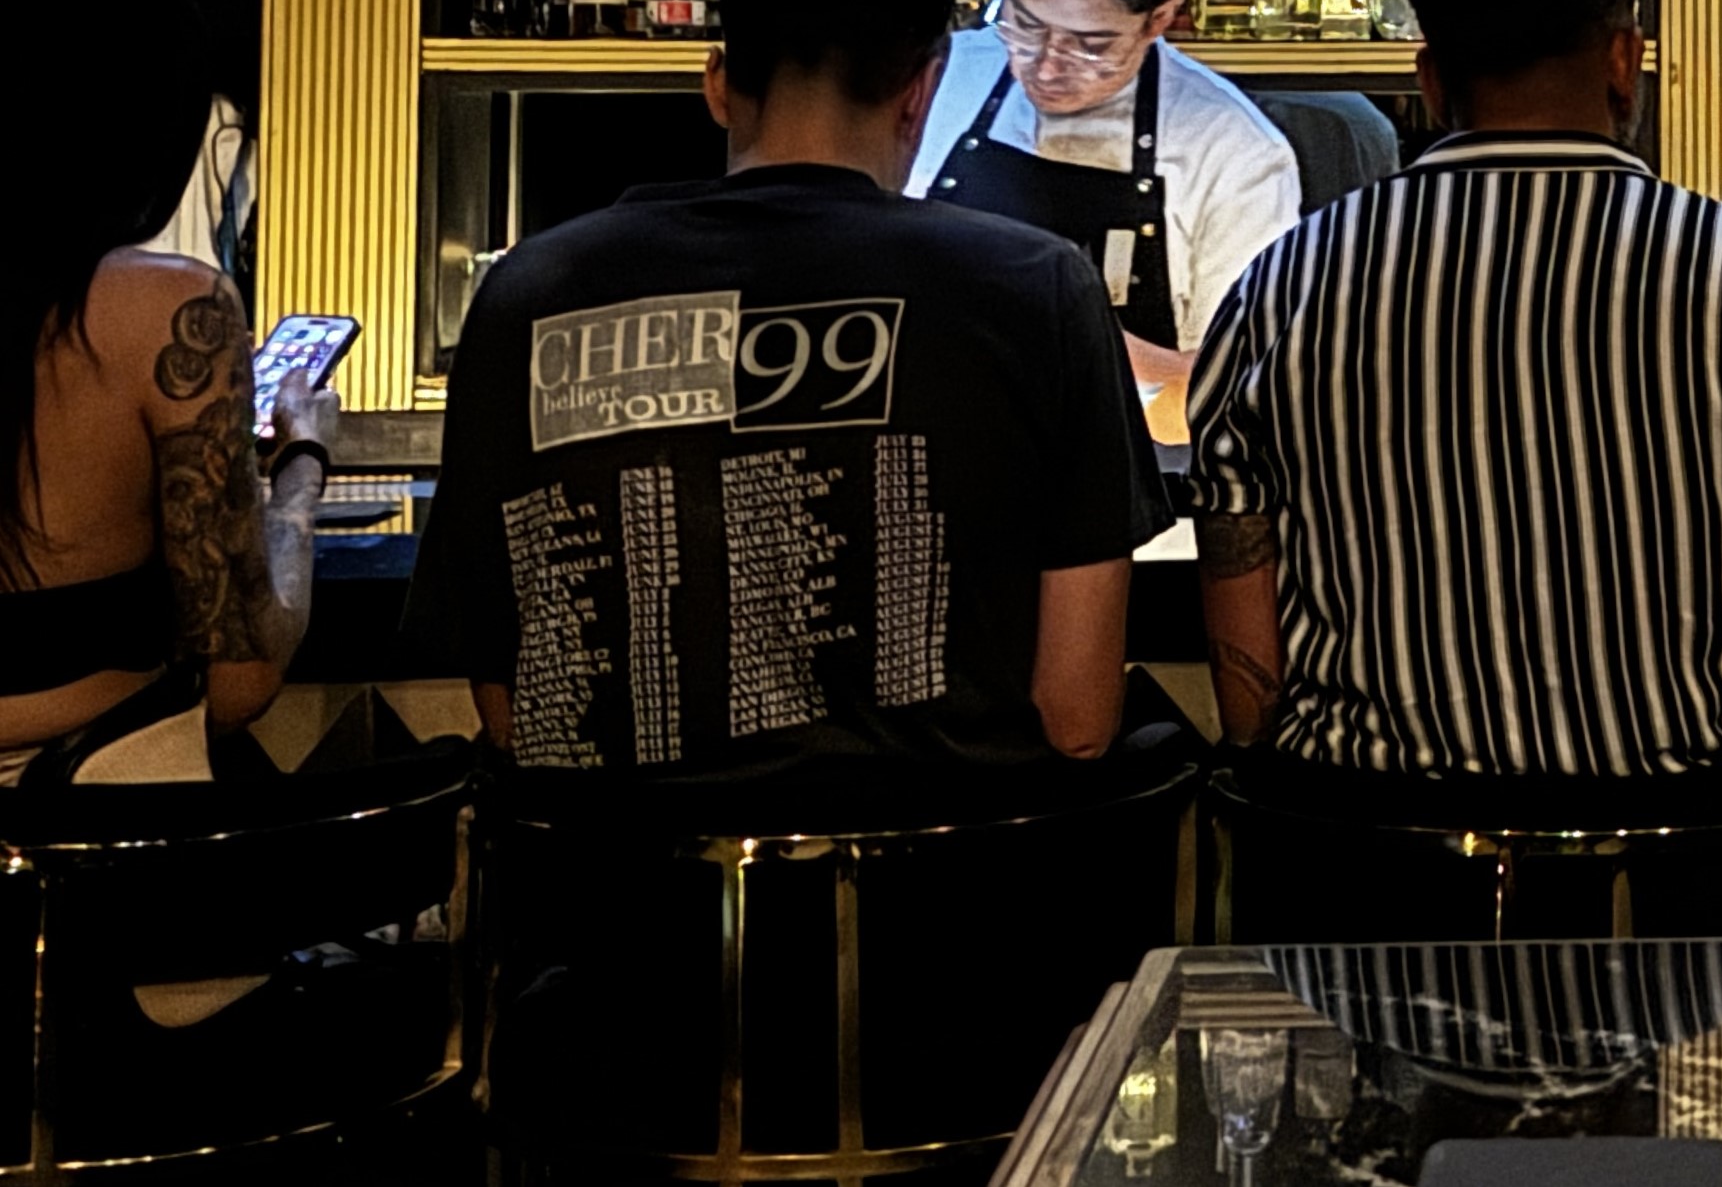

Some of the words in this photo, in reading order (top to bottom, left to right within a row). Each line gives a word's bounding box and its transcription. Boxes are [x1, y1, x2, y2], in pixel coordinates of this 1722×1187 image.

[533, 308, 733, 391] CHER
[737, 310, 889, 415] 99
[542, 384, 622, 415] believe
[598, 388, 724, 426] TOUR
